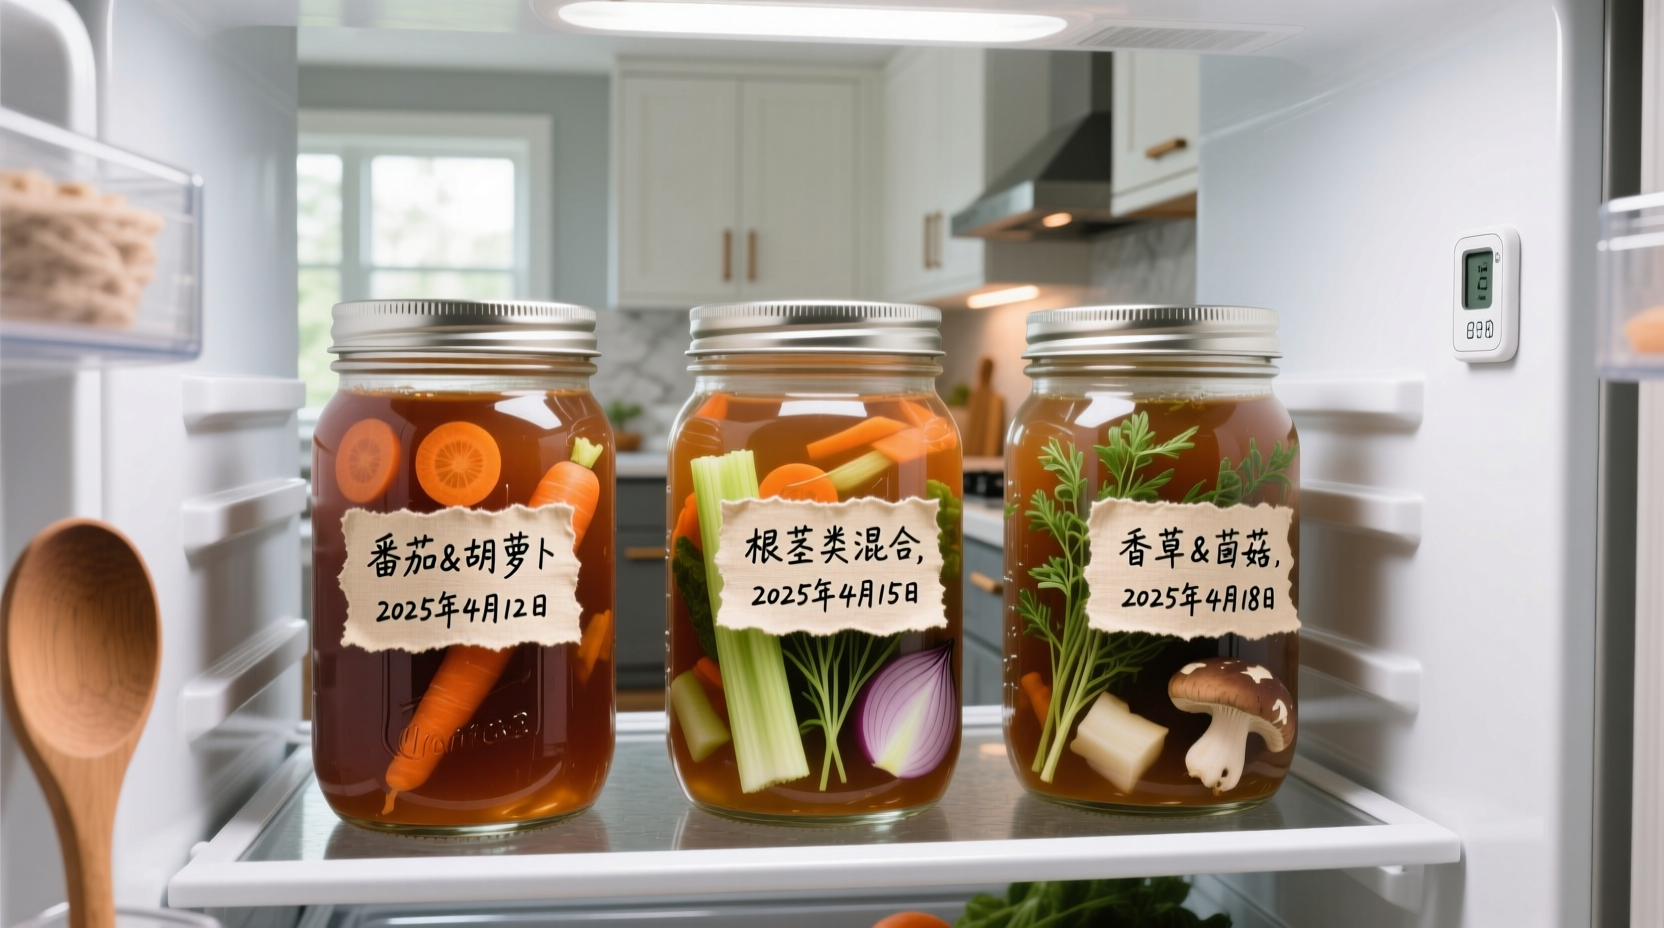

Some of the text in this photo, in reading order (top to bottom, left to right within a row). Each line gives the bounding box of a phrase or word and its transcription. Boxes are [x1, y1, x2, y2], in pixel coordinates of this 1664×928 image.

[366, 530, 555, 580] 番茄&胡萝卜
[744, 524, 924, 566] 根茎类混合,
[375, 590, 547, 630] 2025年4月12日
[751, 577, 918, 613] 2025年4月15日
[1121, 581, 1275, 617] 2025年4月18日
